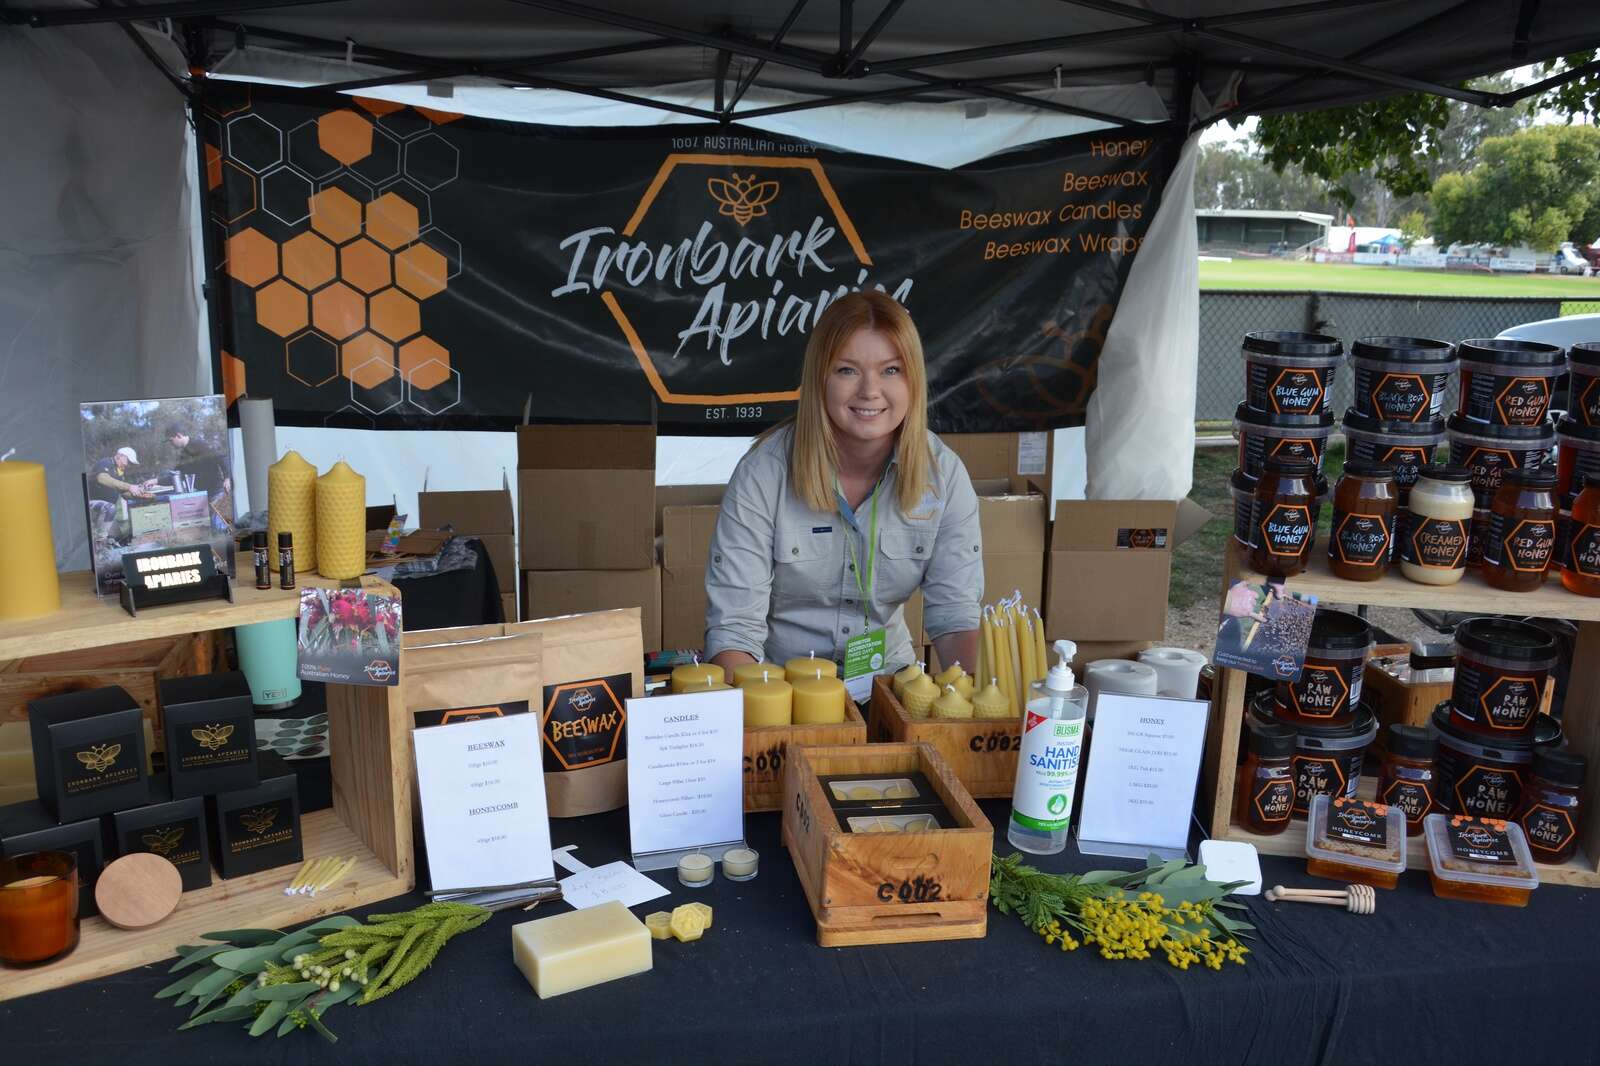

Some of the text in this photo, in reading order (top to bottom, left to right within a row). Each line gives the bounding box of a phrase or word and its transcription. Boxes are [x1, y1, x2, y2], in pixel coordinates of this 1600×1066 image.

[704, 136, 775, 151] AUSTRALIAN
[1063, 170, 1148, 192] Beeswax
[960, 200, 1142, 230] Beeswax Candles
[984, 233, 1145, 260] Beeswax Wraps
[552, 215, 835, 298] Ironbark
[1275, 385, 1319, 396] BLUE GUM
[1282, 397, 1312, 406] HONEY
[1385, 402, 1416, 412] HONEY
[1505, 395, 1524, 406] RED
[706, 406, 762, 419] EST. 1933
[1508, 407, 1540, 417] HONEY
[1472, 476, 1501, 488] HONE
[1268, 522, 1290, 533] BLUE
[1274, 535, 1303, 544] HONEY
[1421, 531, 1463, 545] CREAMED
[1514, 536, 1534, 548] RED
[1346, 541, 1376, 552] HONEY
[1423, 546, 1458, 557] HONEY
[1517, 548, 1548, 560] HONEY
[136, 551, 202, 573] IRONBARK
[144, 569, 202, 589] APIARIES
[1307, 682, 1332, 696] RAW
[1299, 693, 1338, 707] HONEY
[1503, 694, 1529, 707] RAW
[663, 714, 700, 723] CANDLES
[1492, 705, 1530, 719] HONEY
[551, 710, 617, 742] BEESWAX
[1140, 717, 1165, 726] HONEY
[467, 739, 506, 752] BEESWAX
[1045, 745, 1080, 758] HAND
[1299, 774, 1328, 789] RAW
[1477, 784, 1508, 800] RAW
[1271, 795, 1288, 804] RAW
[1466, 797, 1512, 814] HONEY
[468, 801, 519, 816] HONEYCOMB
[1264, 803, 1290, 813] HONEY
[1332, 826, 1382, 838] HONEYCOMB
[1537, 819, 1559, 832] RAW
[1530, 828, 1562, 844] HONEY
[1456, 847, 1509, 856] HONEYCOMB
